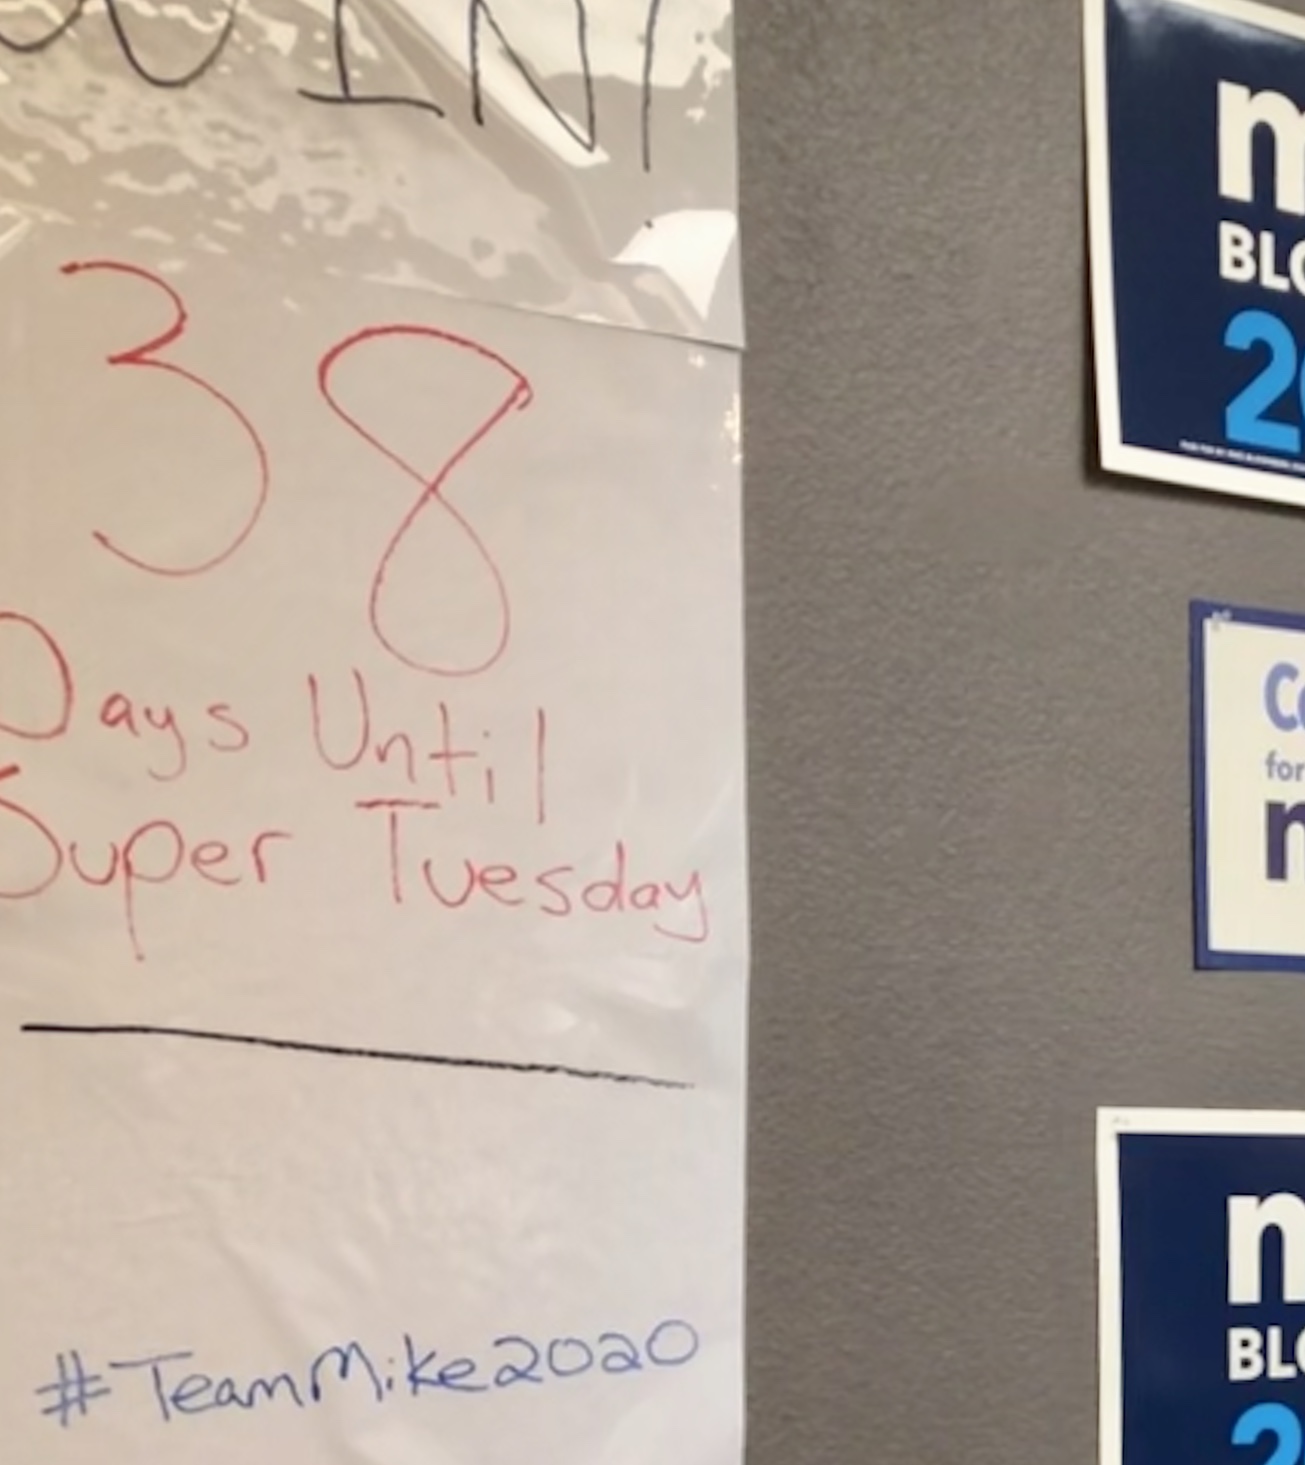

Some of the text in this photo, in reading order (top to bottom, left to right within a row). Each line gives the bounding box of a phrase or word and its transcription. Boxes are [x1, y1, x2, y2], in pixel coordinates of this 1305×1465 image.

[60, 261, 533, 677] 38
[308, 668, 546, 824] Until
[1264, 749, 1305, 783] for
[0, 764, 709, 962] Super Tuesday
[36, 1319, 699, 1426] #TeamMike2020
